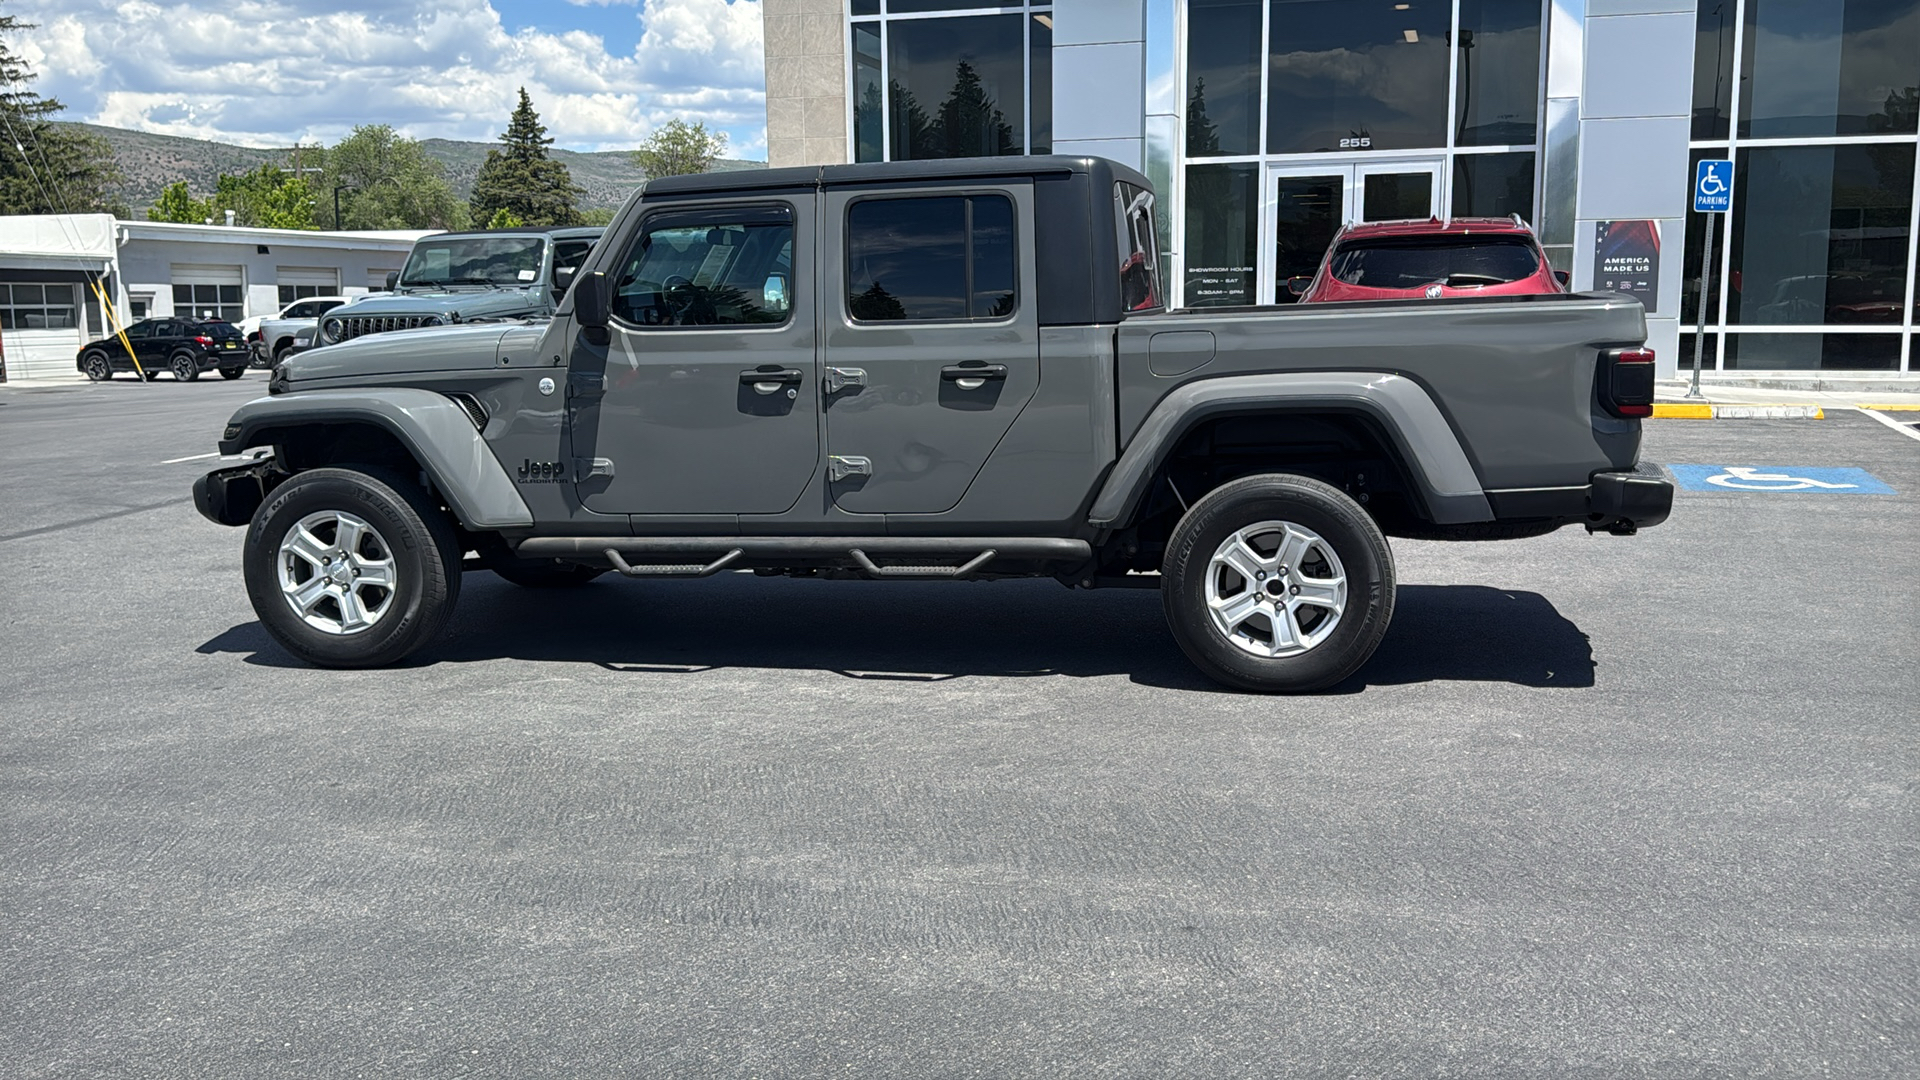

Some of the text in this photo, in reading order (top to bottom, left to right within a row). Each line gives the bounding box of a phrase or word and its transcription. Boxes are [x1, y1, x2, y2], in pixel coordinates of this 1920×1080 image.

[1340, 137, 1370, 148] 255
[1698, 196, 1727, 205] PARKING
[518, 459, 565, 478] Jeep
